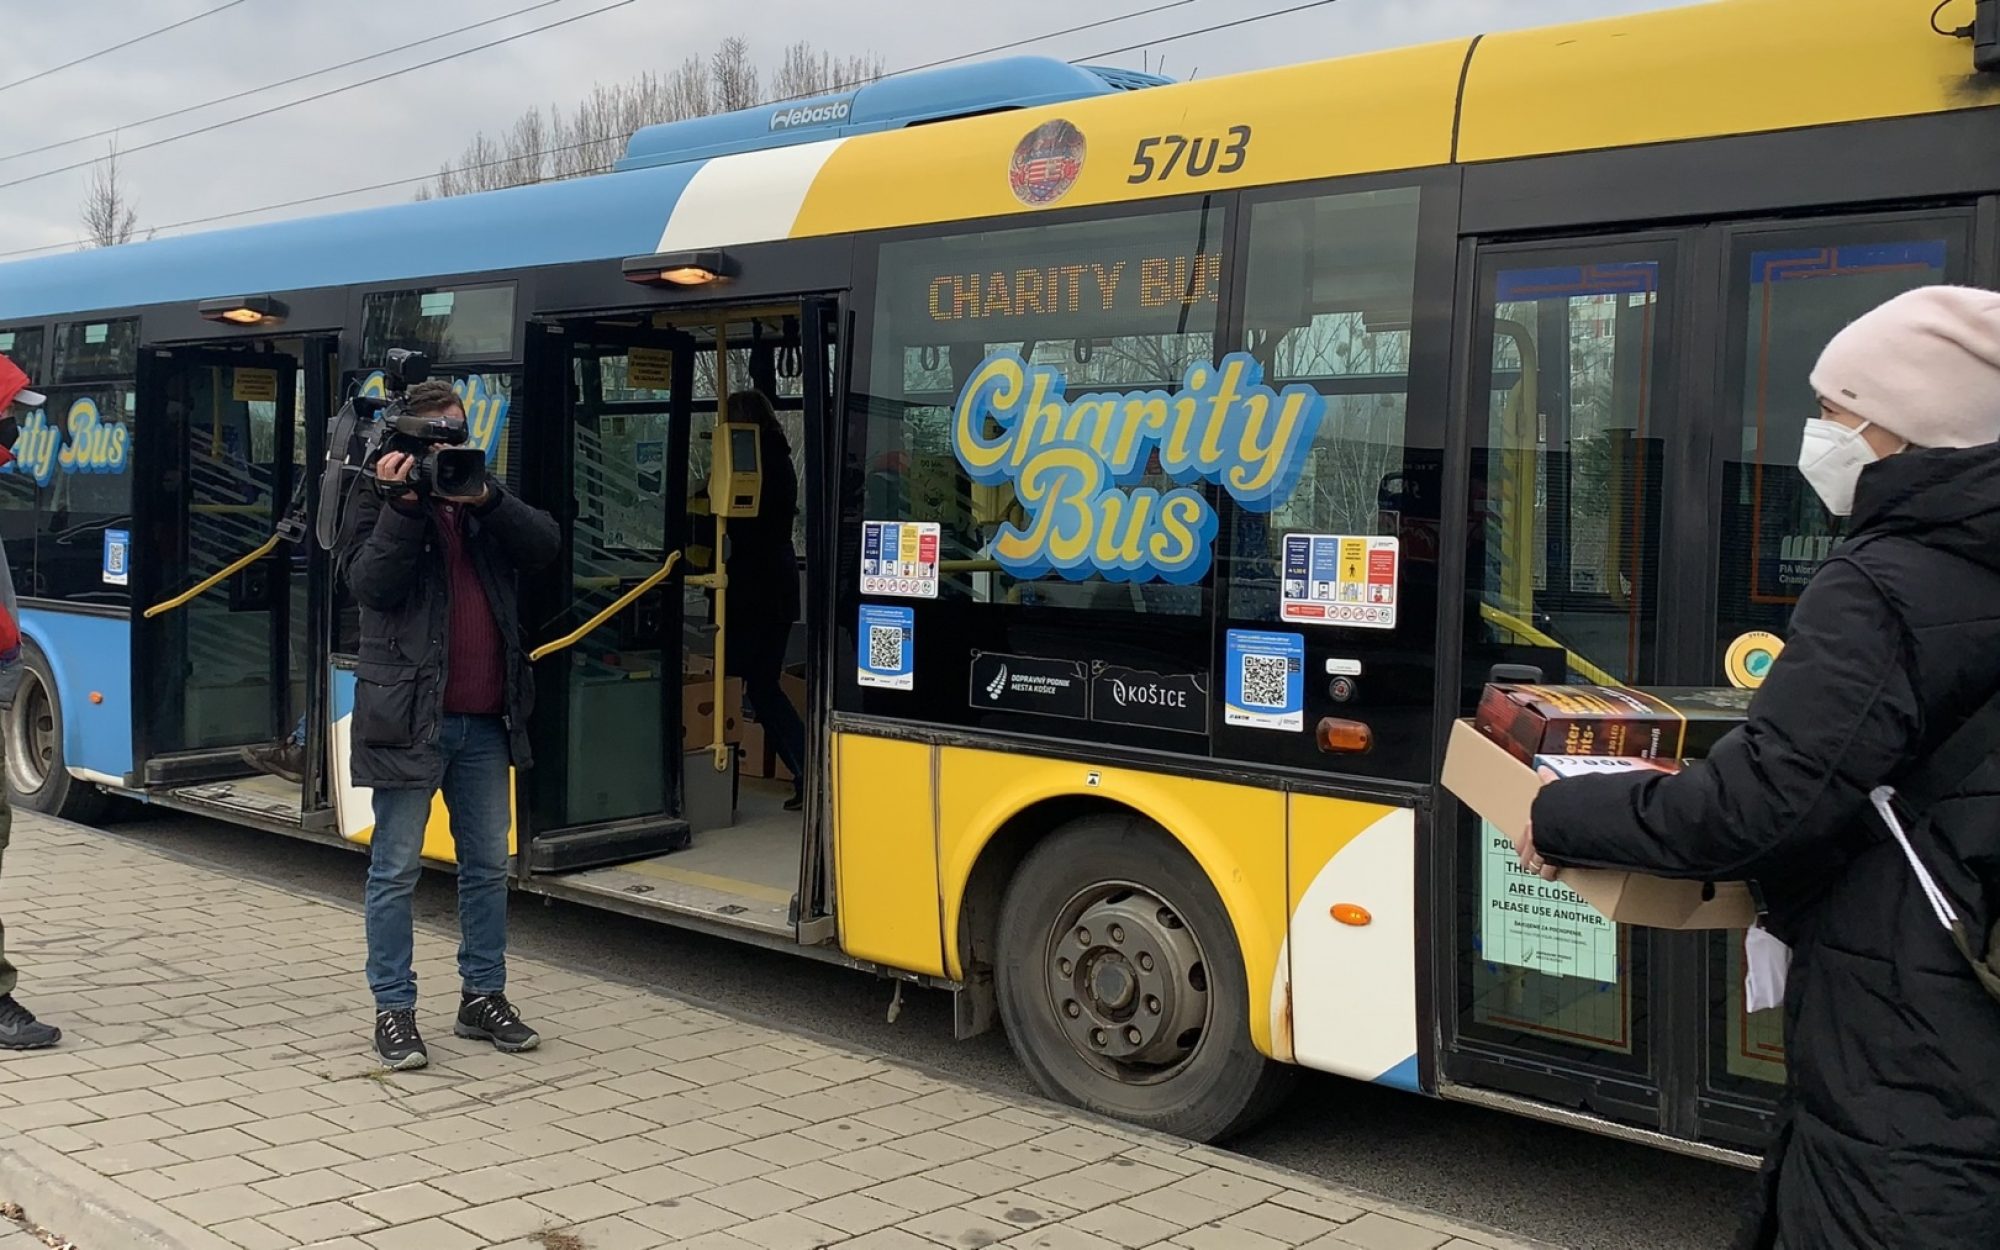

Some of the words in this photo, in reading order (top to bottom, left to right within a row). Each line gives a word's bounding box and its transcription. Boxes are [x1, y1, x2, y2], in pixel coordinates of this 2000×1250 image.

[770, 102, 849, 130] Webasto
[928, 261, 1127, 321] CHARITY
[59, 400, 126, 465] Bus
[955, 354, 1312, 496] Charity
[994, 445, 1204, 568] Bus
[1011, 683, 1033, 692] MESTA
[1128, 684, 1187, 708] KOŠICE
[1509, 882, 1535, 896] ARE
[1492, 899, 1530, 914] PLEASE
[1532, 906, 1552, 918] USE
[1553, 909, 1606, 926] ANOTHER.
